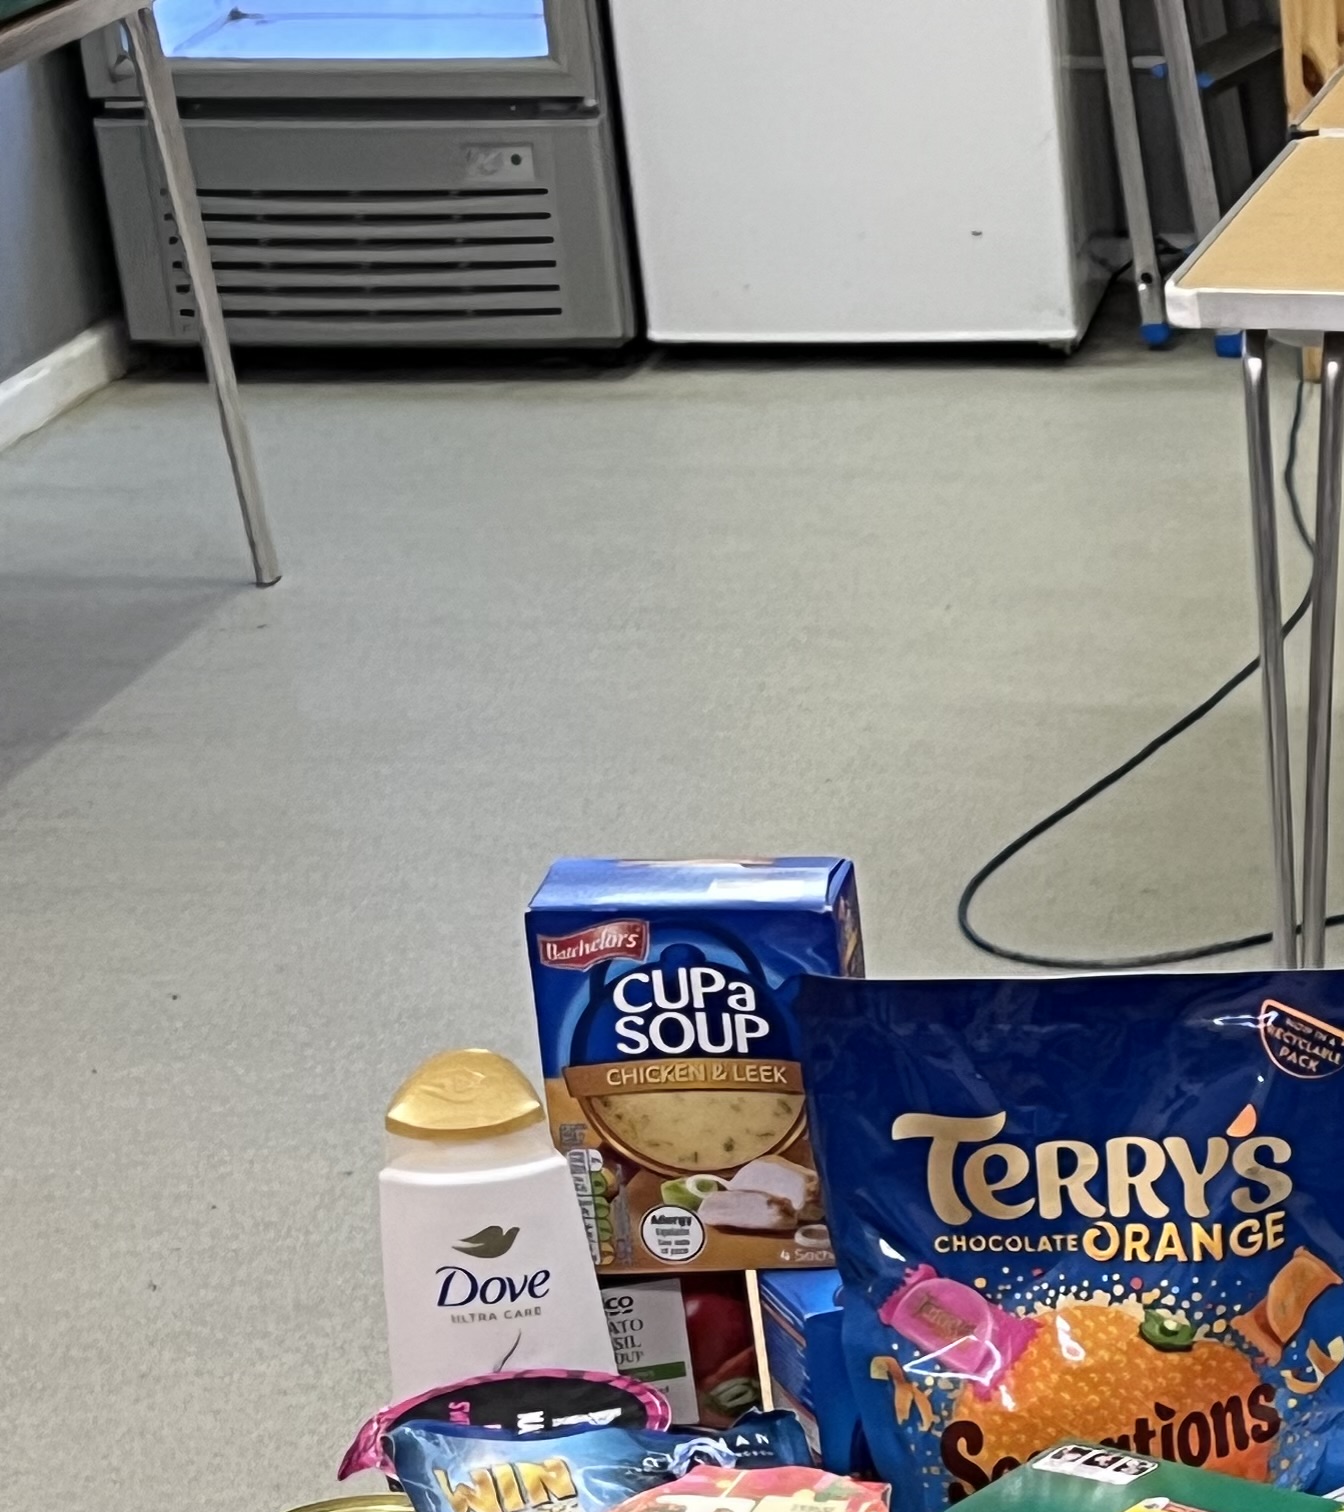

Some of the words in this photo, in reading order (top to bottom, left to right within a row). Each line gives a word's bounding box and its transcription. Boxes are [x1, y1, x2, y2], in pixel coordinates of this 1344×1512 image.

[615, 1011, 769, 1054] SOUP
[606, 1064, 706, 1087] CHICKEN
[734, 1064, 788, 1085] LEEK
[1278, 1047, 1320, 1073] PACK
[934, 1234, 1078, 1253] CHOCOLATE
[1083, 1210, 1286, 1262] ORANGE
[436, 1266, 551, 1307] Dove
